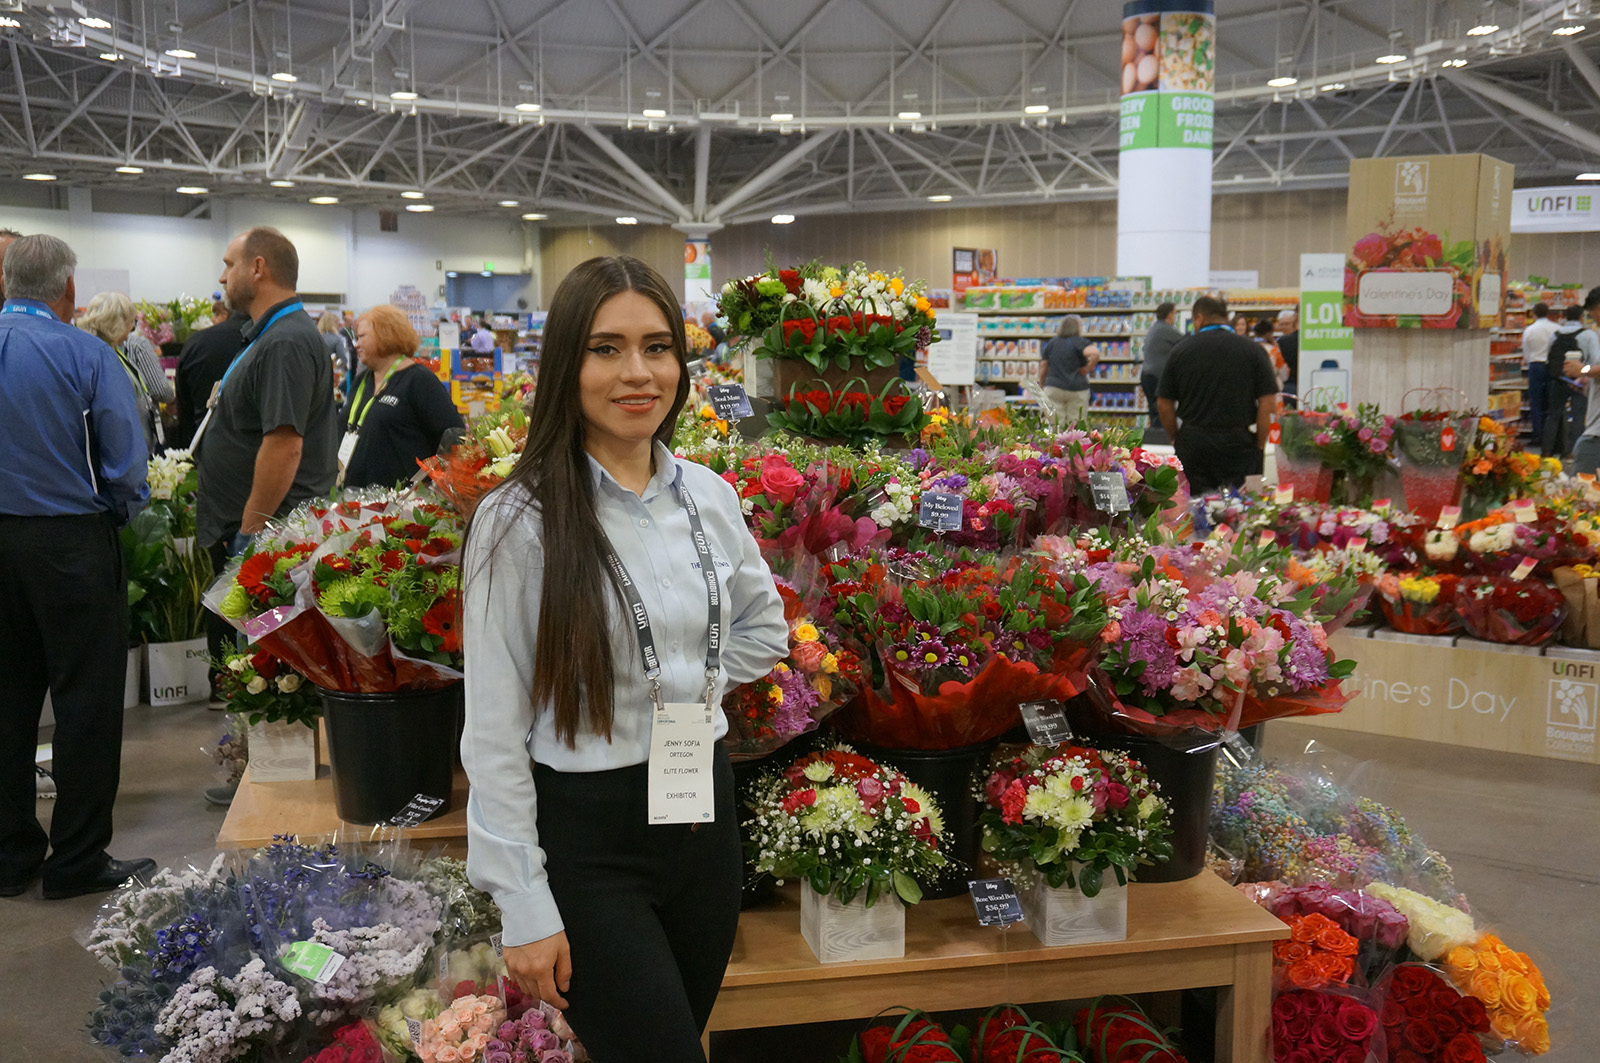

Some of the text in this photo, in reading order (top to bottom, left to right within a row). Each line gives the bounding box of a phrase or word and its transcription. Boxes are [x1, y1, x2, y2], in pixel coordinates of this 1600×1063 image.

[1528, 195, 1572, 212] UNFI
[1427, 287, 1450, 302] Day
[924, 501, 959, 512] My Beloved
[930, 511, 949, 519] $9.99
[694, 531, 708, 554] UNFI
[706, 570, 719, 606] EXHIBITOR
[632, 602, 647, 630] UNFI
[710, 623, 719, 649] UNFI
[1553, 661, 1595, 679] UNFI
[154, 685, 188, 699] UNFI
[1448, 677, 1516, 722] Day
[1546, 726, 1595, 742] Bouquet
[985, 903, 1010, 912] $36.99
